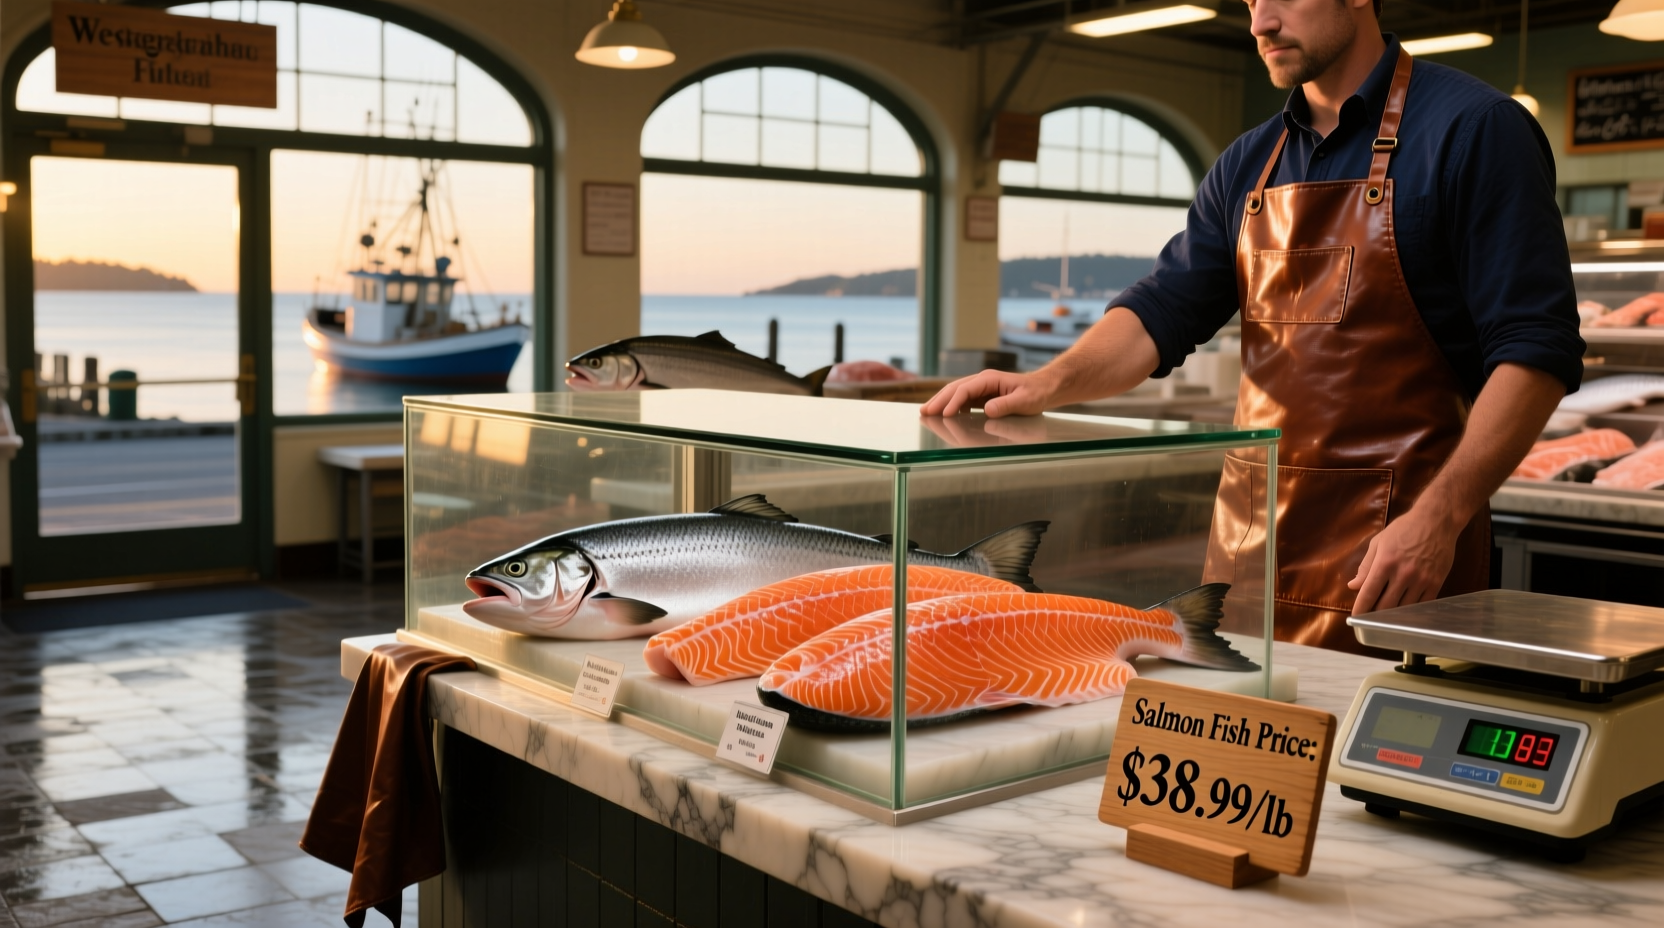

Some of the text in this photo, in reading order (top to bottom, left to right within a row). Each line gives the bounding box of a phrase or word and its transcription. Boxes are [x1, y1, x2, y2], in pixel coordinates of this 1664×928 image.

[1132, 698, 1318, 761] Salmon Fish Price:
[1117, 746, 1294, 838] $38.99/lb
